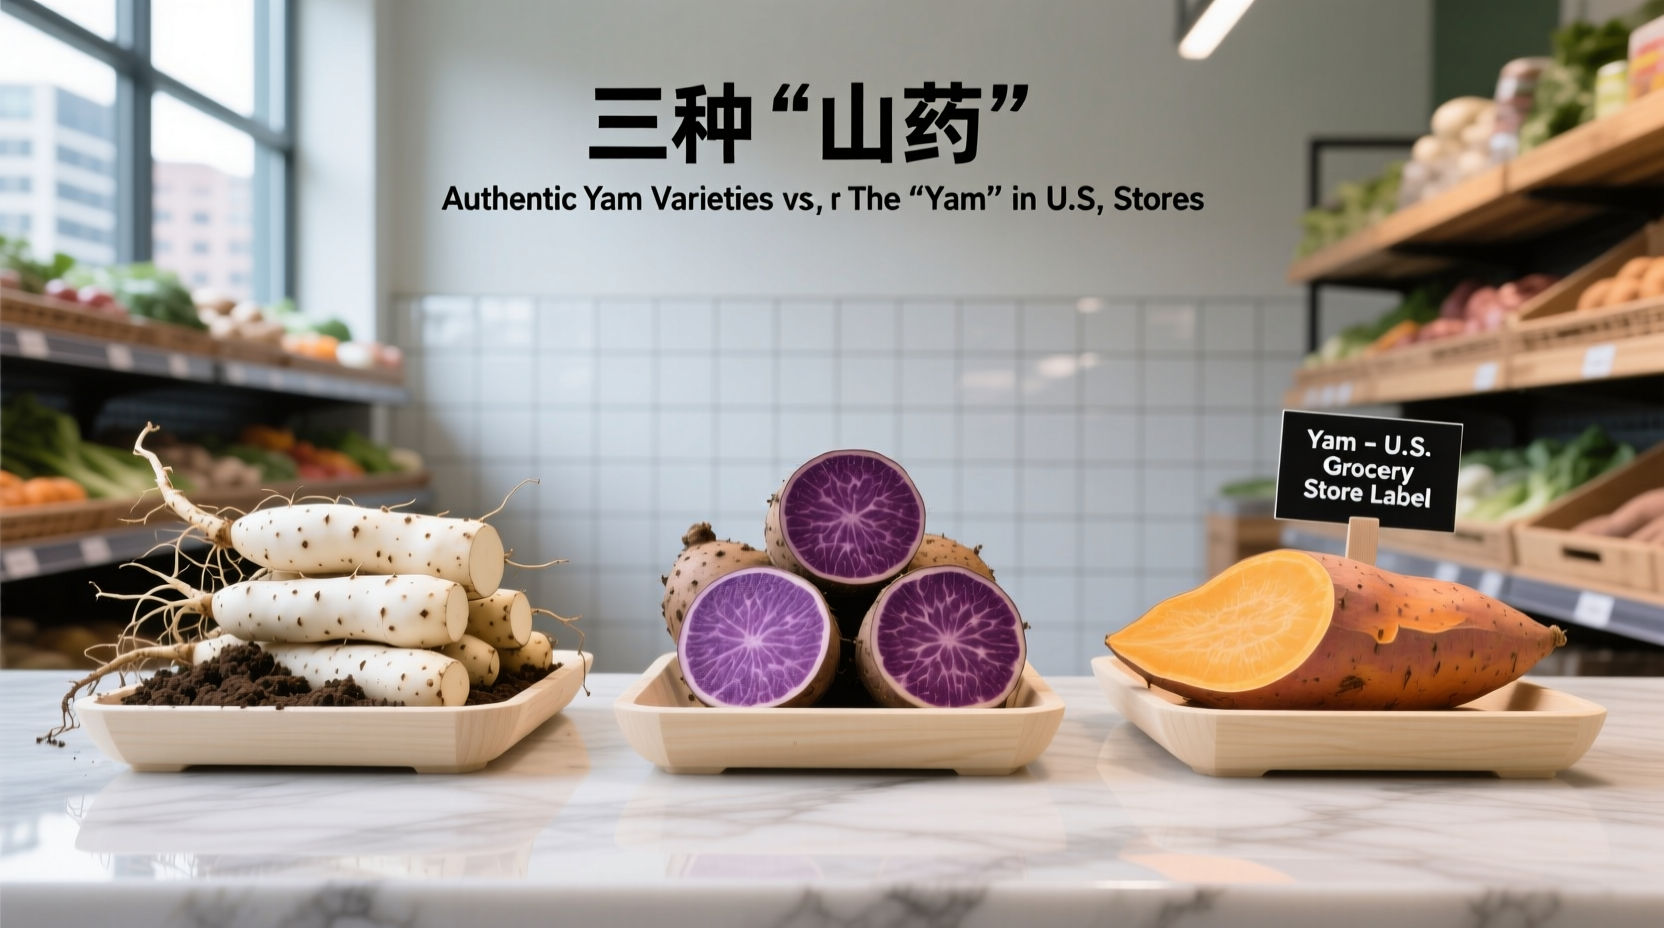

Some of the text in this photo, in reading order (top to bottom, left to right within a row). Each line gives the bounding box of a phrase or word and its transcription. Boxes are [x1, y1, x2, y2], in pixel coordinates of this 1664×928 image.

[1307, 428, 1356, 452] Yam
[1384, 434, 1431, 457] U.S.
[1323, 455, 1415, 486] Grocery
[1303, 478, 1431, 509] Store Label
